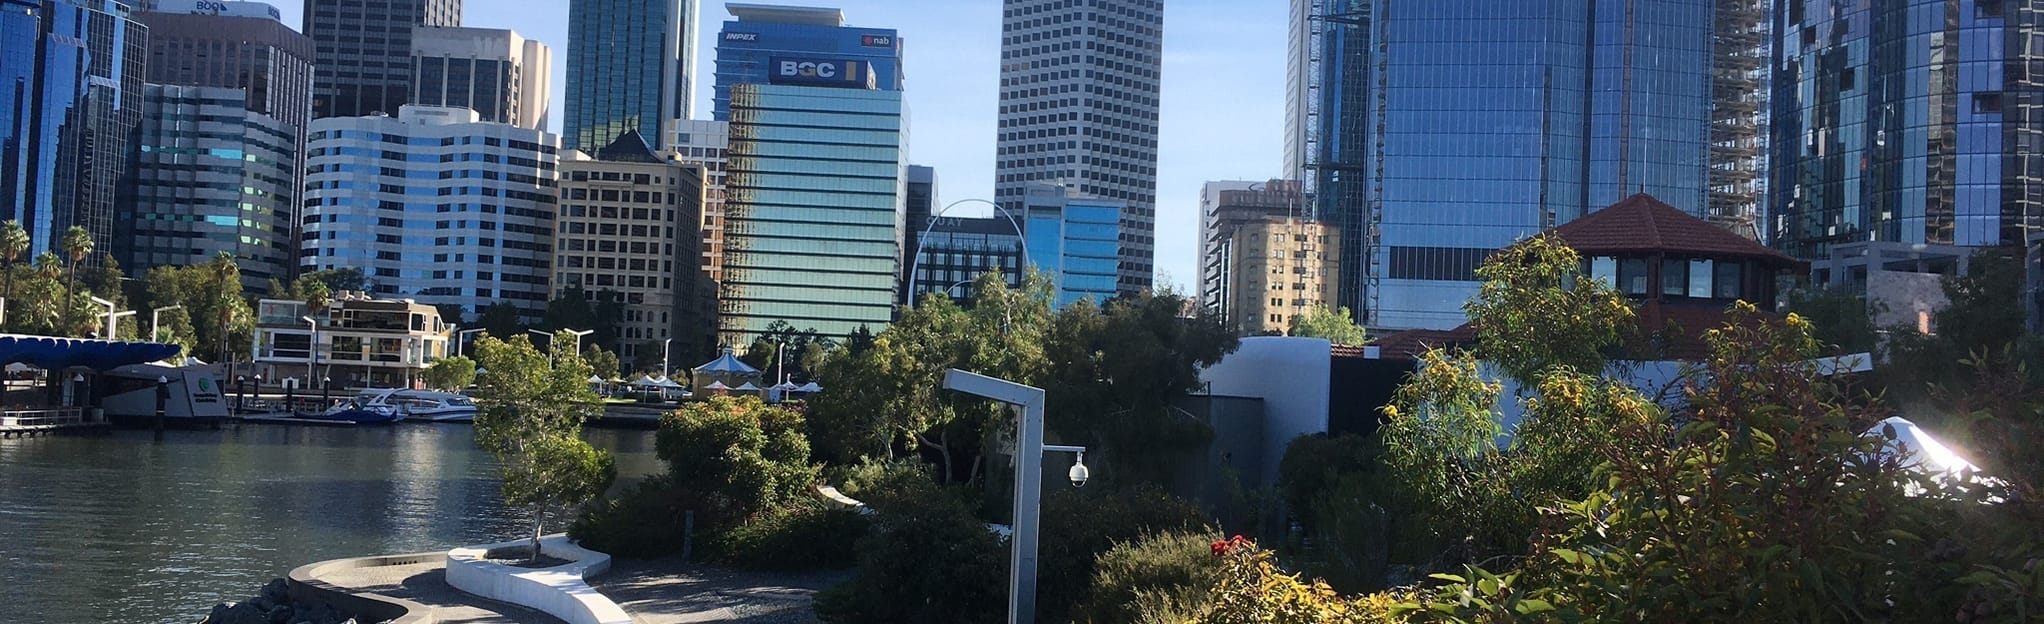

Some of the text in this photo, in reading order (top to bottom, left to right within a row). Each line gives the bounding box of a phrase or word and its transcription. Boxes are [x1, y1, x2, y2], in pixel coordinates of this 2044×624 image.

[726, 33, 757, 41] INPEX
[873, 36, 889, 45] nab
[780, 60, 836, 78] BGC
